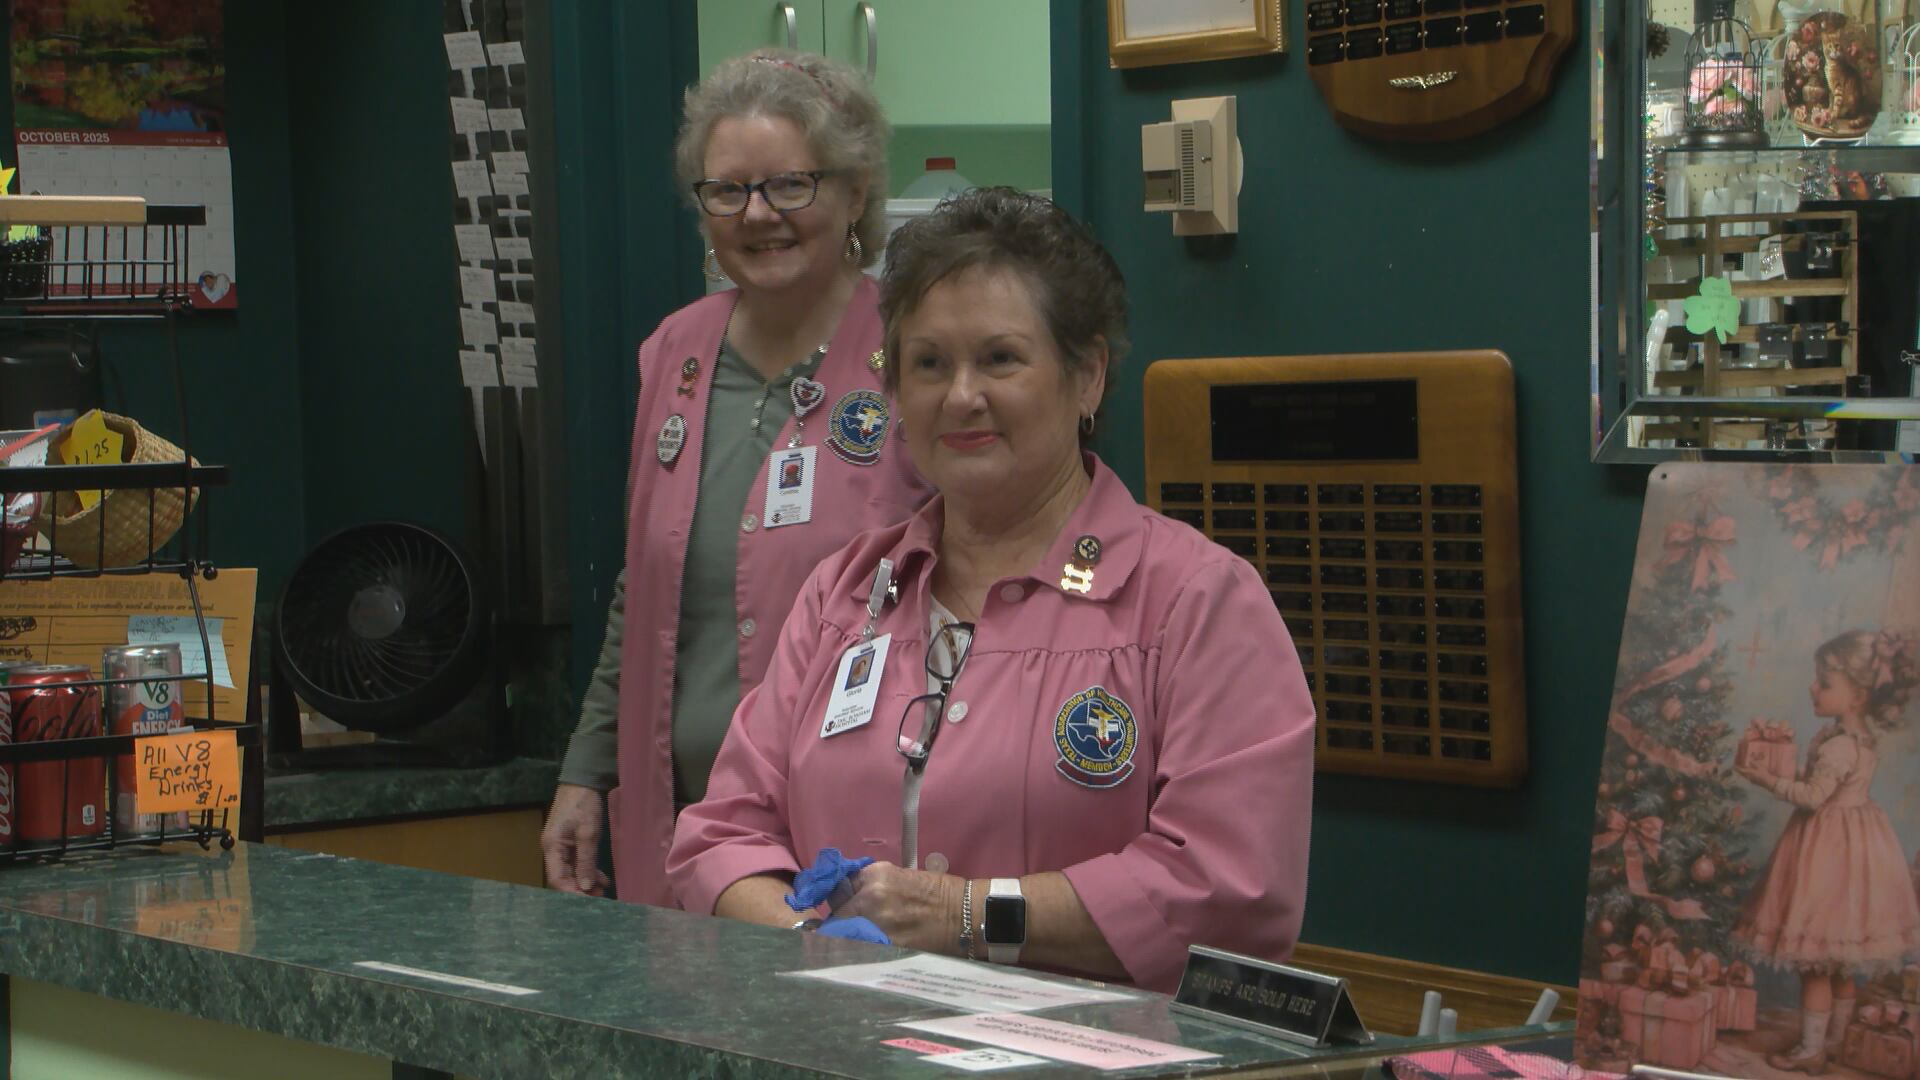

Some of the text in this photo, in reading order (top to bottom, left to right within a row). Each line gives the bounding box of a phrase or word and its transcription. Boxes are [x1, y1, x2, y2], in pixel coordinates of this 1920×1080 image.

[19, 132, 110, 143] OCTOBER 2025
[143, 681, 169, 704] V8
[147, 711, 169, 720] Diet
[144, 740, 211, 765] All V8
[149, 762, 211, 783] Energy
[159, 777, 212, 796] Drinks
[1191, 971, 1317, 1016] STAMPS ARE SOLD HERE
